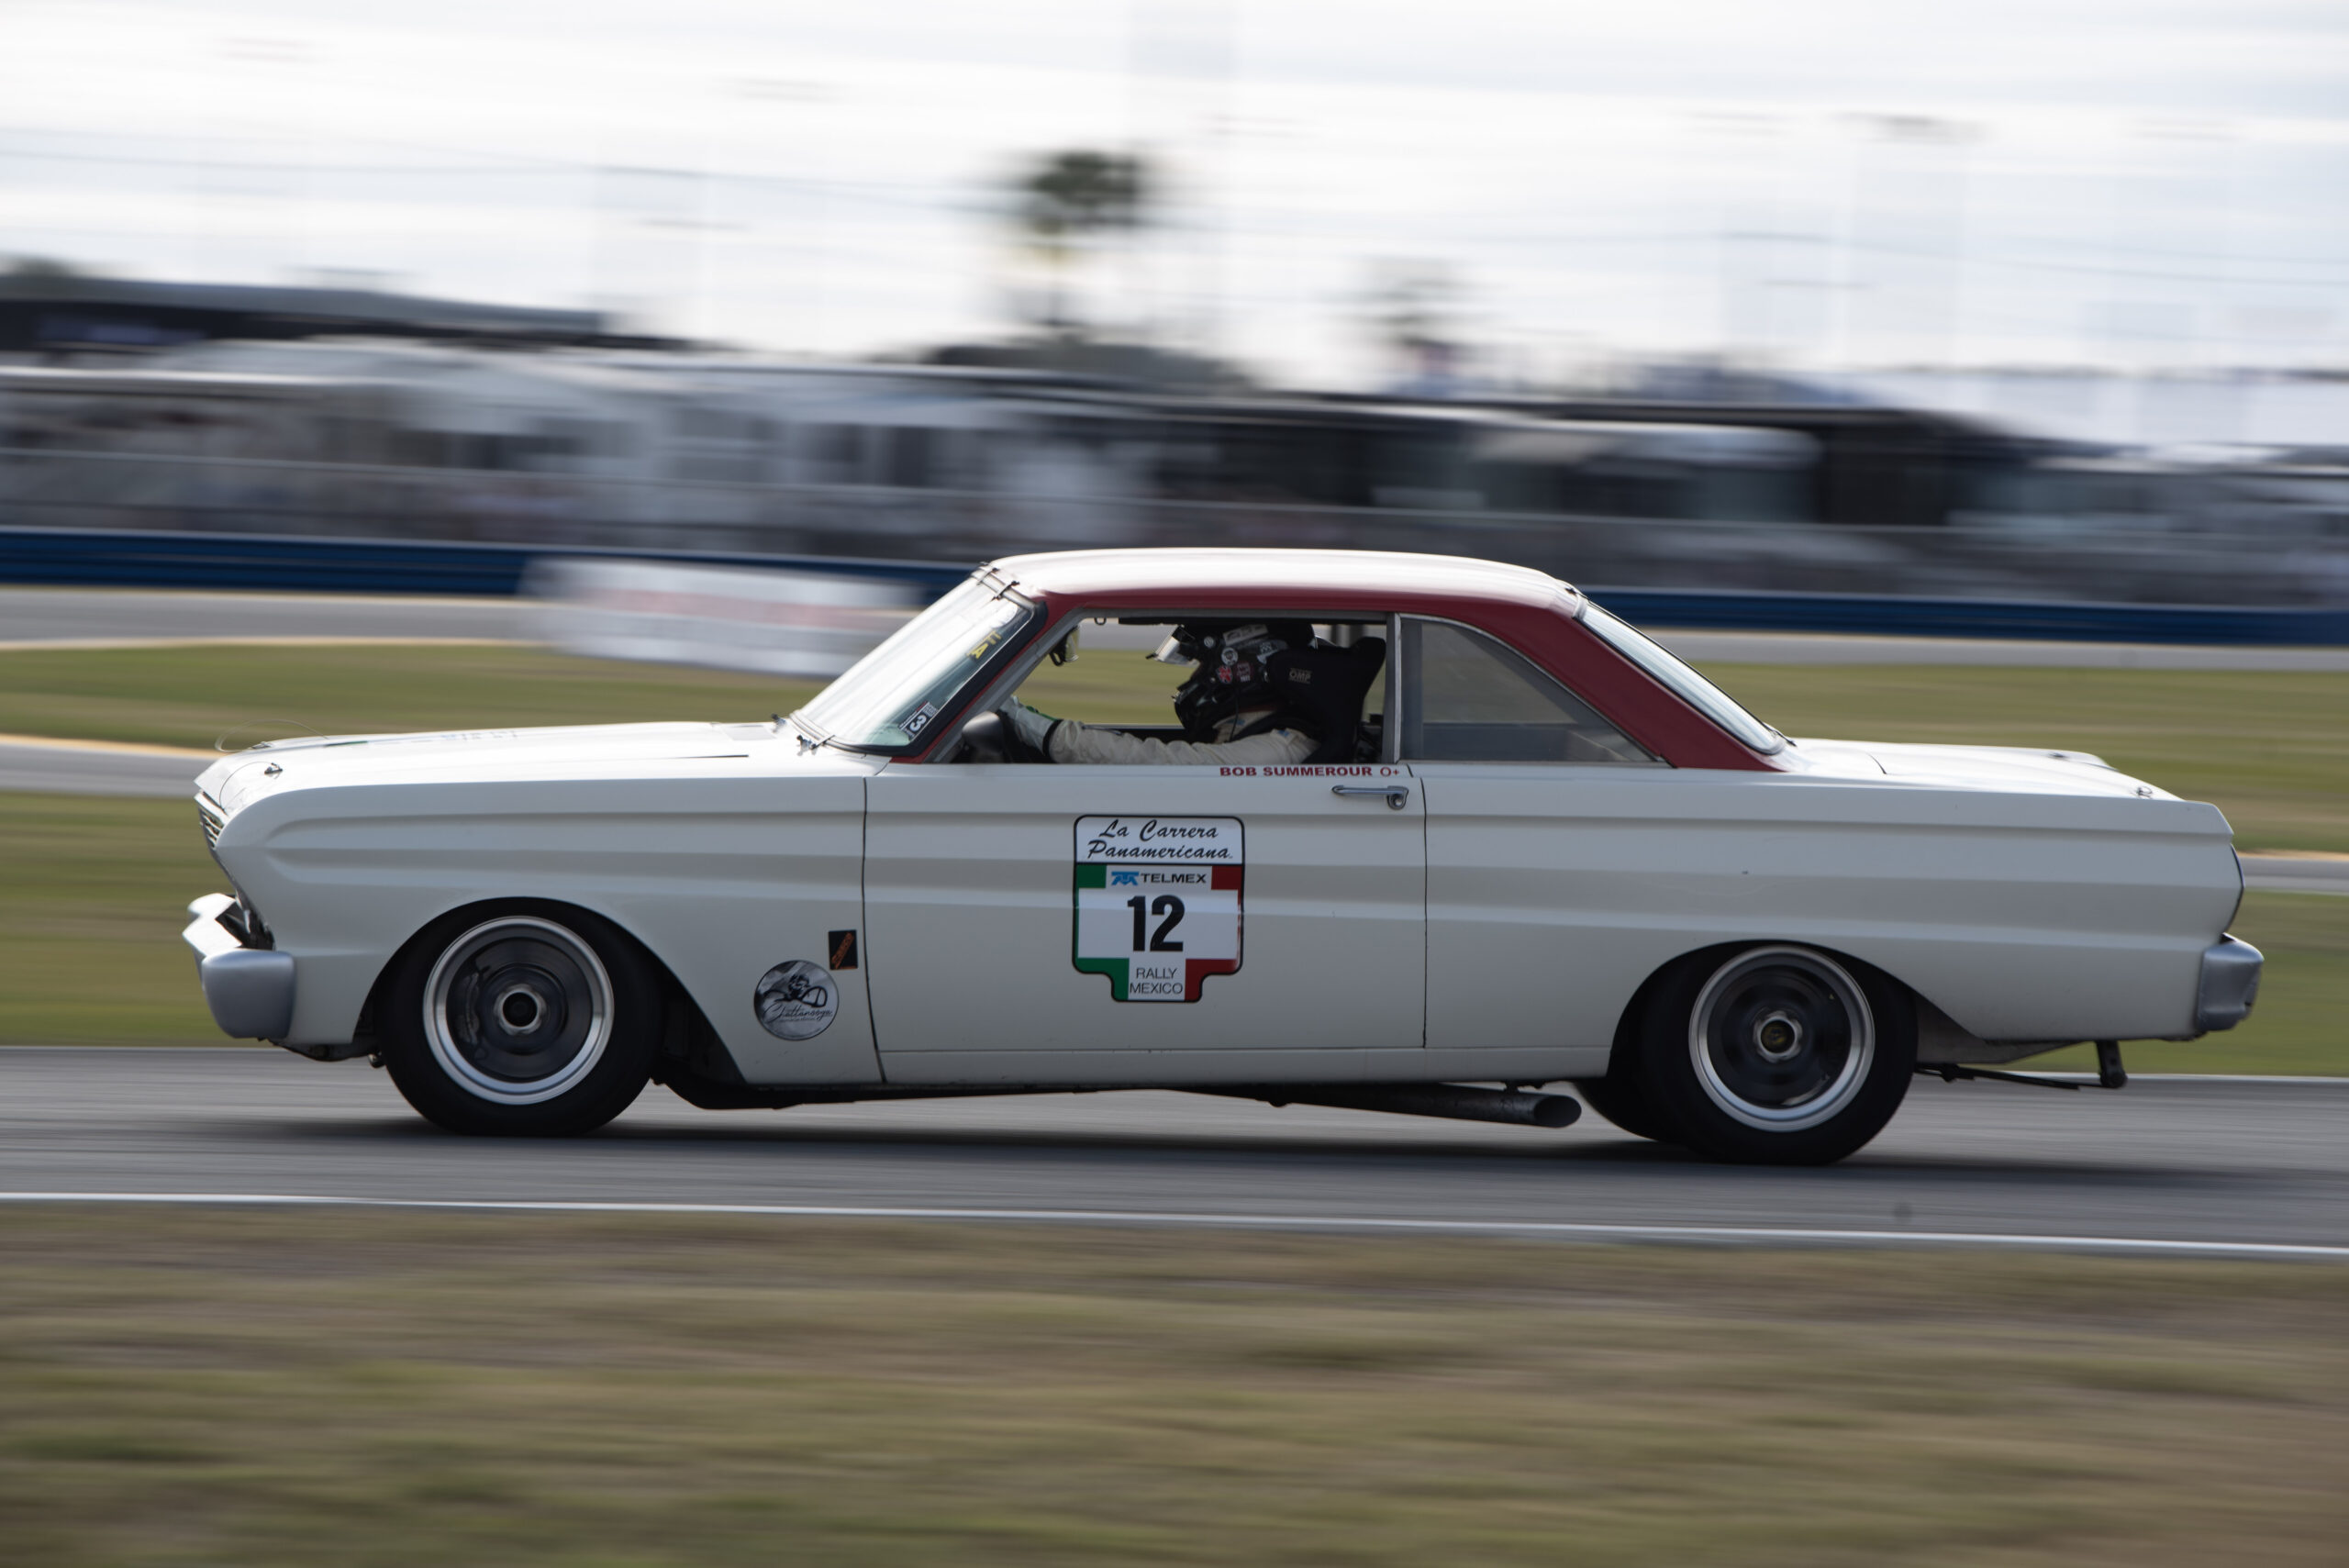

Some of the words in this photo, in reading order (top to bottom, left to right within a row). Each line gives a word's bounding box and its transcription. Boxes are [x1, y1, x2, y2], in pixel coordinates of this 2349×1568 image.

[909, 714, 927, 732] 3
[1219, 766, 1257, 777] BOB
[1263, 766, 1373, 777] SUMMEROUR
[1380, 766, 1400, 778] O+
[1098, 818, 1130, 839] La
[1139, 819, 1219, 842] Carrera
[1086, 839, 1230, 860] Panamericana
[1140, 873, 1208, 884] TELMEX
[1127, 894, 1186, 952] 12
[1135, 967, 1178, 980] RALLY
[1129, 982, 1184, 995] MEXICO
